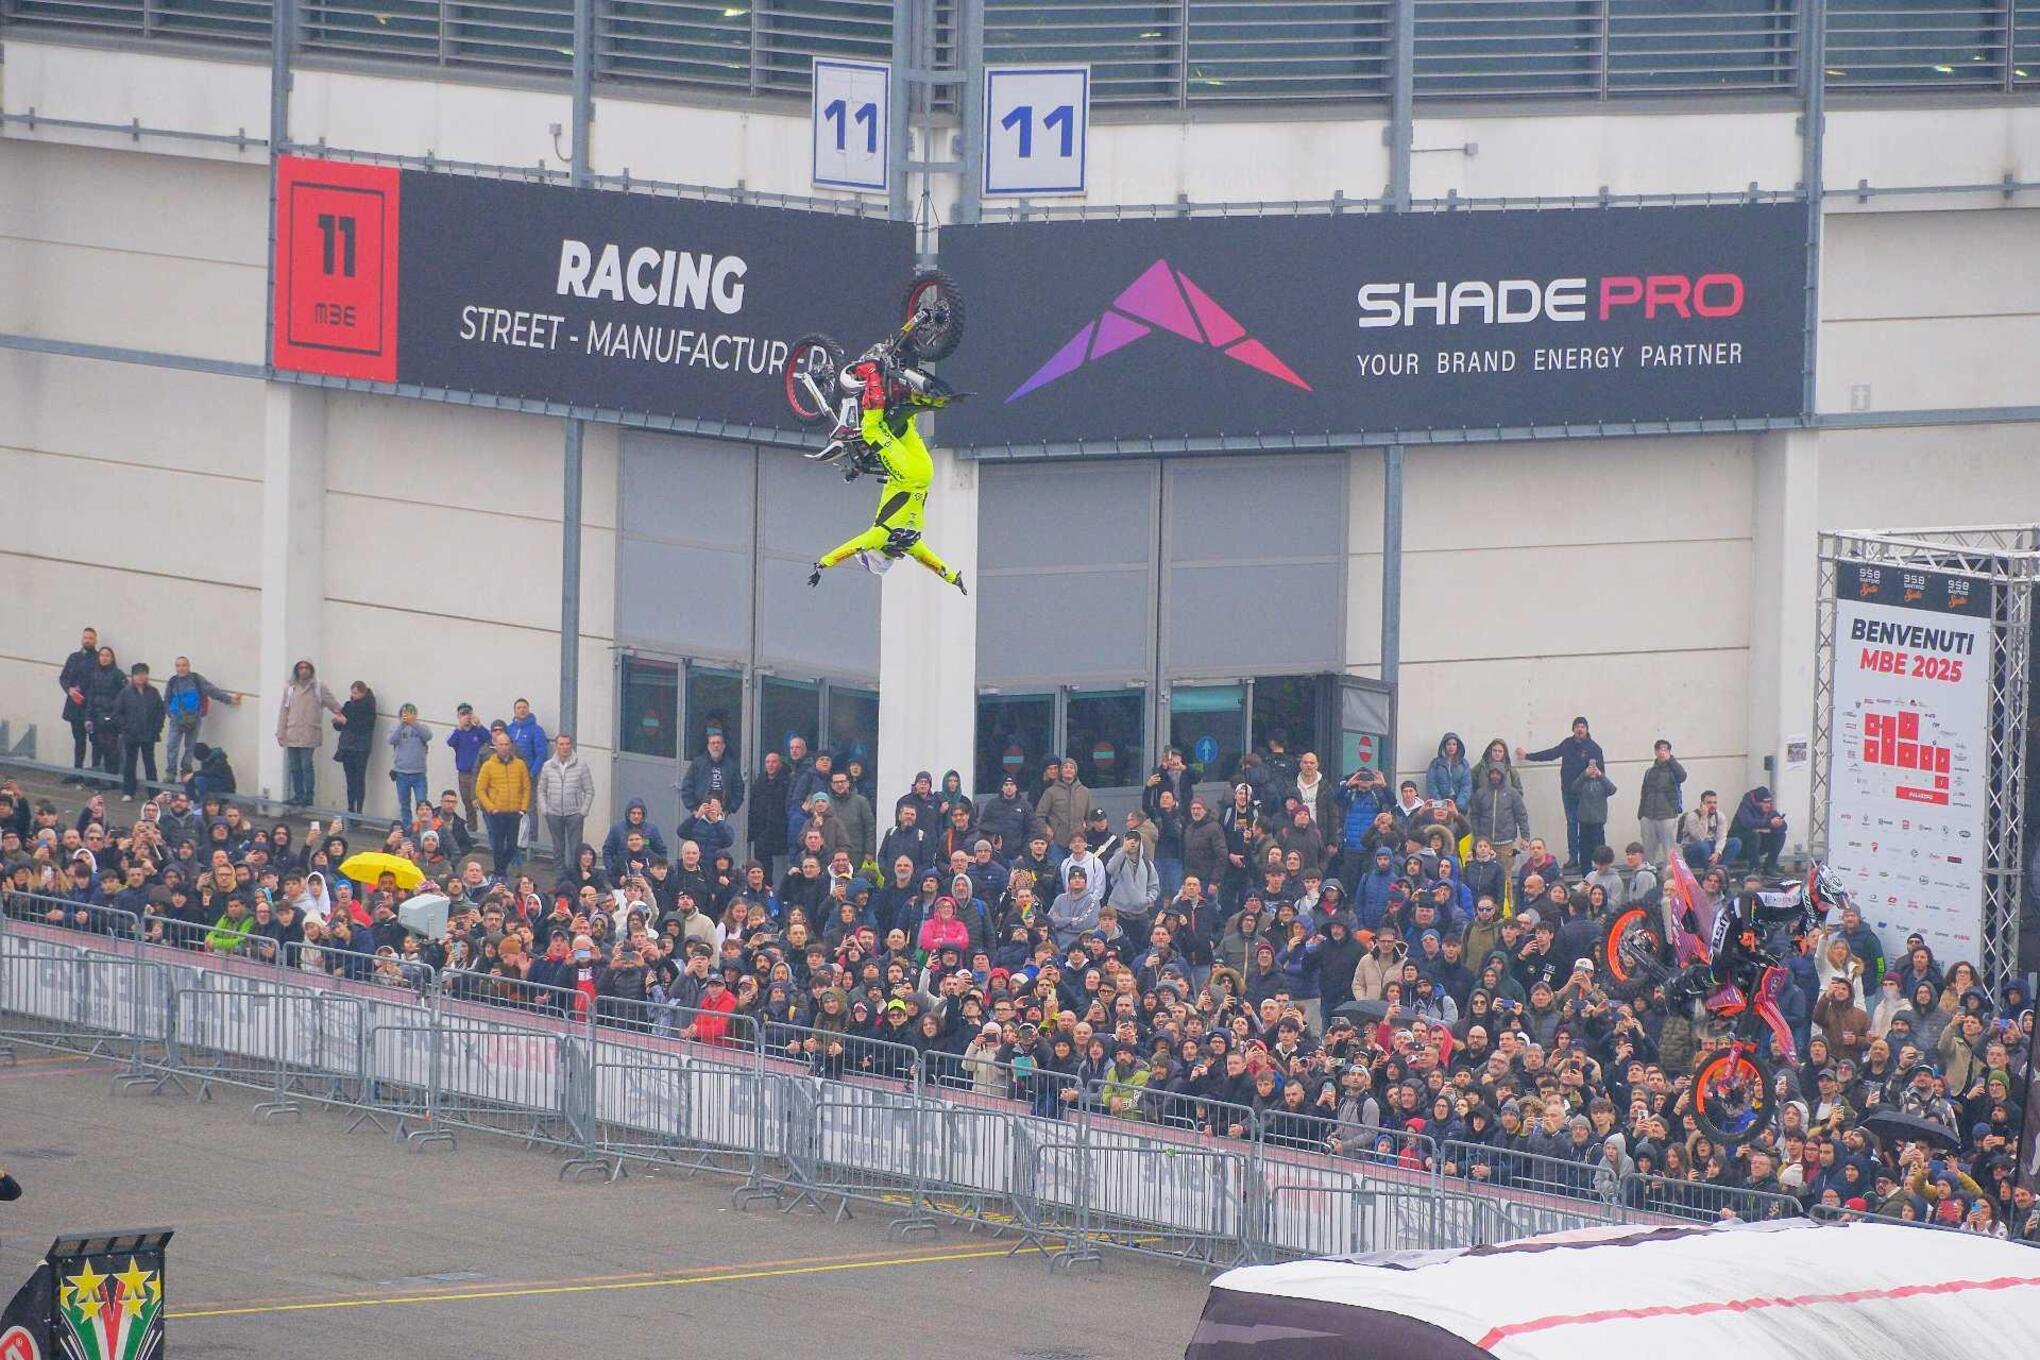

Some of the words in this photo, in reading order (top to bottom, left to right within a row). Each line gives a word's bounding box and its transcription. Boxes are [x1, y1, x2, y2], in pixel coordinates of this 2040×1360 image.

[823, 98, 878, 154] 11
[1001, 104, 1075, 159] 11
[317, 213, 356, 277] 11
[556, 239, 748, 315] RACING
[459, 305, 565, 350] STREET
[1356, 352, 1419, 376] YOUR
[1436, 350, 1516, 374] BRAND
[1534, 346, 1624, 372] ENERGY
[1641, 342, 1743, 367] PARTNER
[1851, 618, 1975, 656] BENVENUTI
[1859, 648, 1908, 676] MBE
[1911, 655, 1964, 683] 2025
